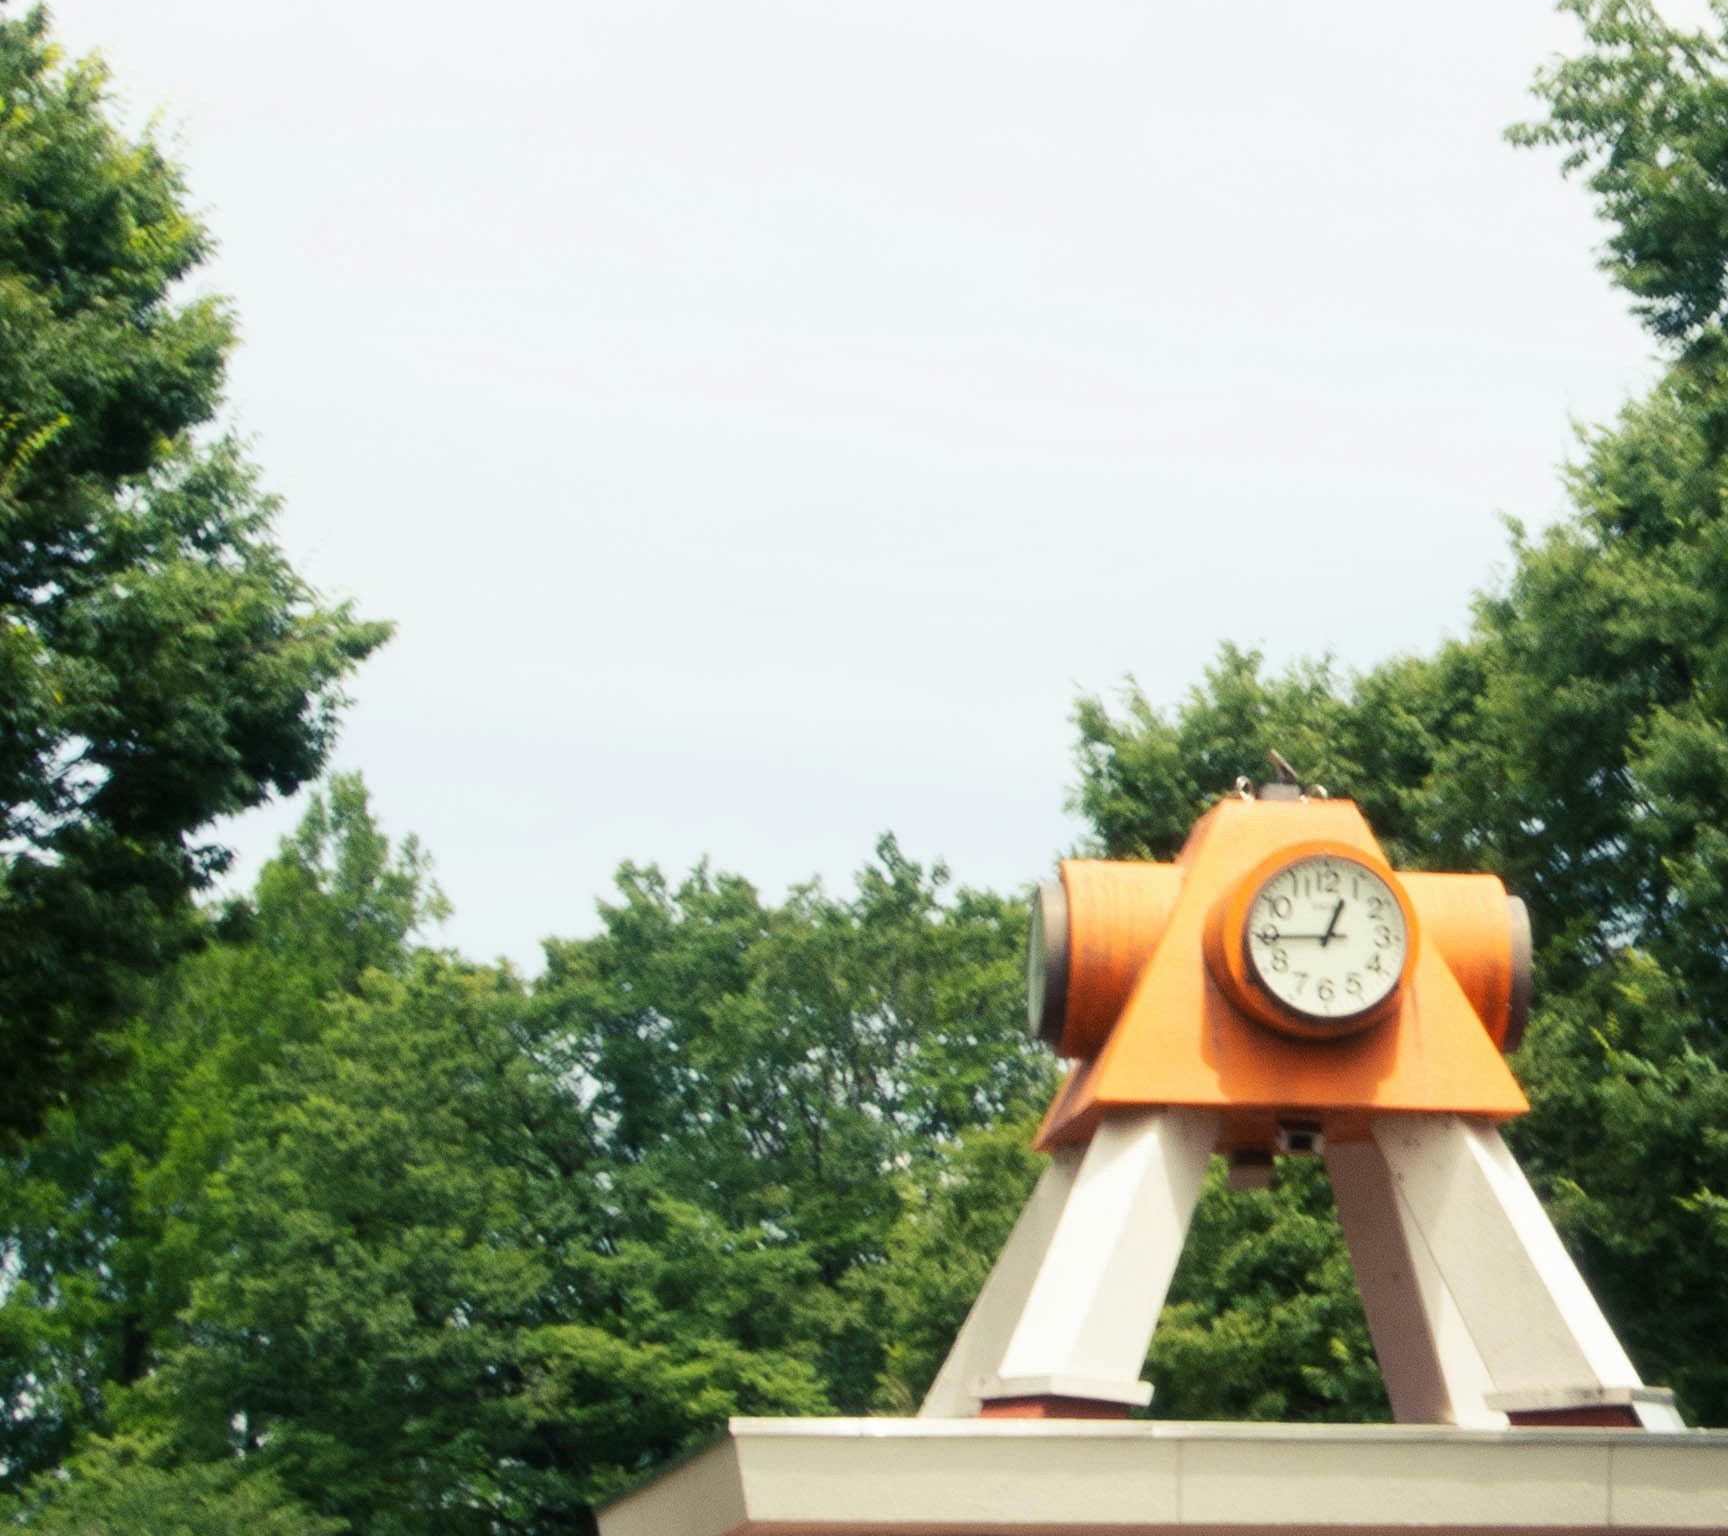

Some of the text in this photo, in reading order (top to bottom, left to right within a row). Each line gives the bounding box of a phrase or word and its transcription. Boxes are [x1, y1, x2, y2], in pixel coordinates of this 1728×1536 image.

[1292, 872, 1310, 899] 11
[1316, 870, 1339, 893] 12
[1352, 876, 1359, 900] 1
[1268, 895, 1292, 920] 10
[1366, 897, 1384, 920] 2
[1260, 922, 1280, 946] 9
[1374, 924, 1391, 949] 3
[1271, 948, 1288, 972] 8
[1365, 953, 1381, 974] 4
[1292, 970, 1308, 995] 7
[1317, 977, 1335, 1001] 6
[1345, 970, 1362, 995] 5
